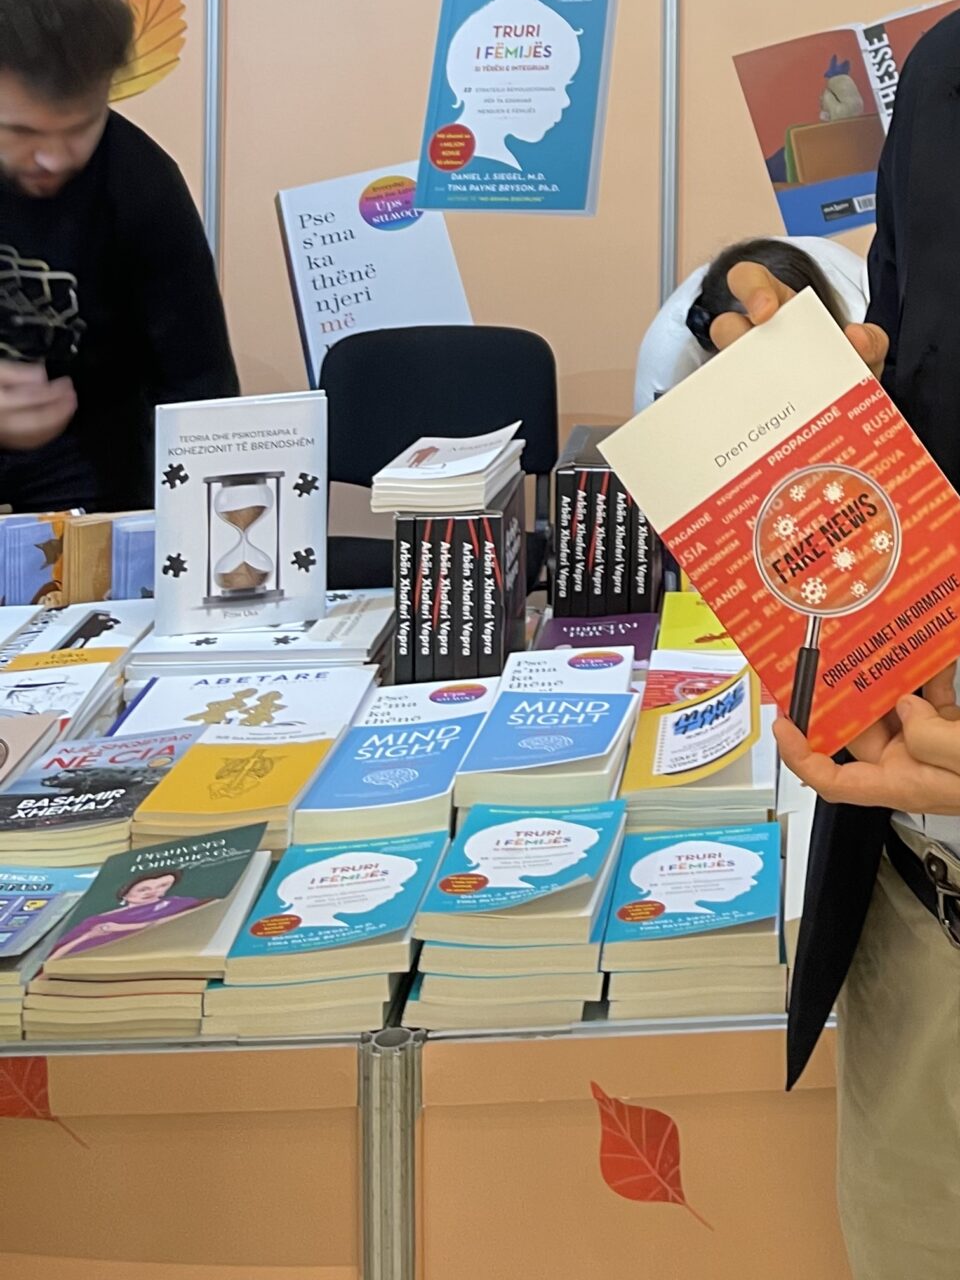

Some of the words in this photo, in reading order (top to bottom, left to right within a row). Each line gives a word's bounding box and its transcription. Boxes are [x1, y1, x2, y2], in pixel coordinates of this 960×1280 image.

[493, 24, 540, 38] TRURI
[476, 47, 481, 60] I
[484, 41, 553, 60] FËMIJËS
[447, 183, 467, 192] TINA
[451, 173, 482, 181] DANIEL
[299, 211, 336, 229] Pse
[375, 199, 403, 212] Ups
[306, 254, 335, 270] ka
[311, 263, 377, 291] thënë
[315, 286, 373, 314] njeri
[320, 313, 357, 334] më
[167, 442, 233, 457] KOHEZIONIT
[236, 441, 248, 452] TË
[250, 437, 315, 451] BRENDSHËM
[179, 434, 210, 443] TEORIA
[212, 433, 230, 441] DHE
[231, 429, 291, 440] PSIKOTERAPIA
[714, 440, 749, 469] Dren
[747, 401, 797, 444] Gërguri
[767, 405, 842, 467] PROPAGANDË
[560, 495, 572, 527] Arbën
[576, 489, 588, 522] Arbën
[595, 492, 606, 525] Arbën
[616, 491, 628, 524] Arbën
[721, 493, 760, 525] UKRAINA
[559, 527, 571, 566] Xhaferi
[575, 522, 587, 561] Xhaferi
[594, 524, 606, 564] Xhaferi
[614, 524, 627, 563] Xhaferi
[637, 523, 649, 563] Xhaferi
[666, 511, 714, 550] PAGANDË
[771, 533, 826, 584] FAKE
[819, 493, 878, 548] NEWS
[400, 541, 412, 577] Arbën
[421, 541, 433, 577] Arbën
[439, 541, 452, 577] Arbën
[462, 541, 474, 577] Arbën
[483, 541, 496, 577] Arbën
[556, 566, 569, 598] Vepra
[572, 560, 586, 592] Vepra
[591, 563, 604, 595] Vepra
[613, 563, 625, 594] Vepra
[636, 563, 648, 595] Vepra
[399, 577, 411, 620] Xhaferi
[421, 577, 433, 620] Xhaferi
[439, 577, 452, 620] Xhaferi
[461, 577, 474, 620] Xhaferi
[483, 576, 495, 619] Xhaferi
[396, 621, 411, 656] Vepra
[420, 621, 433, 656] Vepra
[439, 621, 452, 656] Vepra
[461, 621, 474, 656] Vepra
[483, 620, 496, 655] Vepra
[852, 669, 871, 692] NË
[869, 646, 911, 681] EPOKËN
[908, 606, 958, 651] DIGJITALE
[822, 623, 898, 688] ÇRREGULLIMET
[193, 671, 330, 686] ABETARE
[507, 712, 611, 726] SIGHT
[513, 700, 611, 714] MIND
[353, 736, 460, 761] SIGHT
[362, 724, 462, 748] MIND
[108, 744, 178, 766] CIA
[9, 799, 115, 820] XHEMAJ
[17, 788, 126, 809] BASHMIR
[515, 829, 562, 838] TRURI
[331, 863, 380, 874] TRURI
[669, 860, 736, 872] FËMIJËS
[675, 852, 723, 862] TRURI
